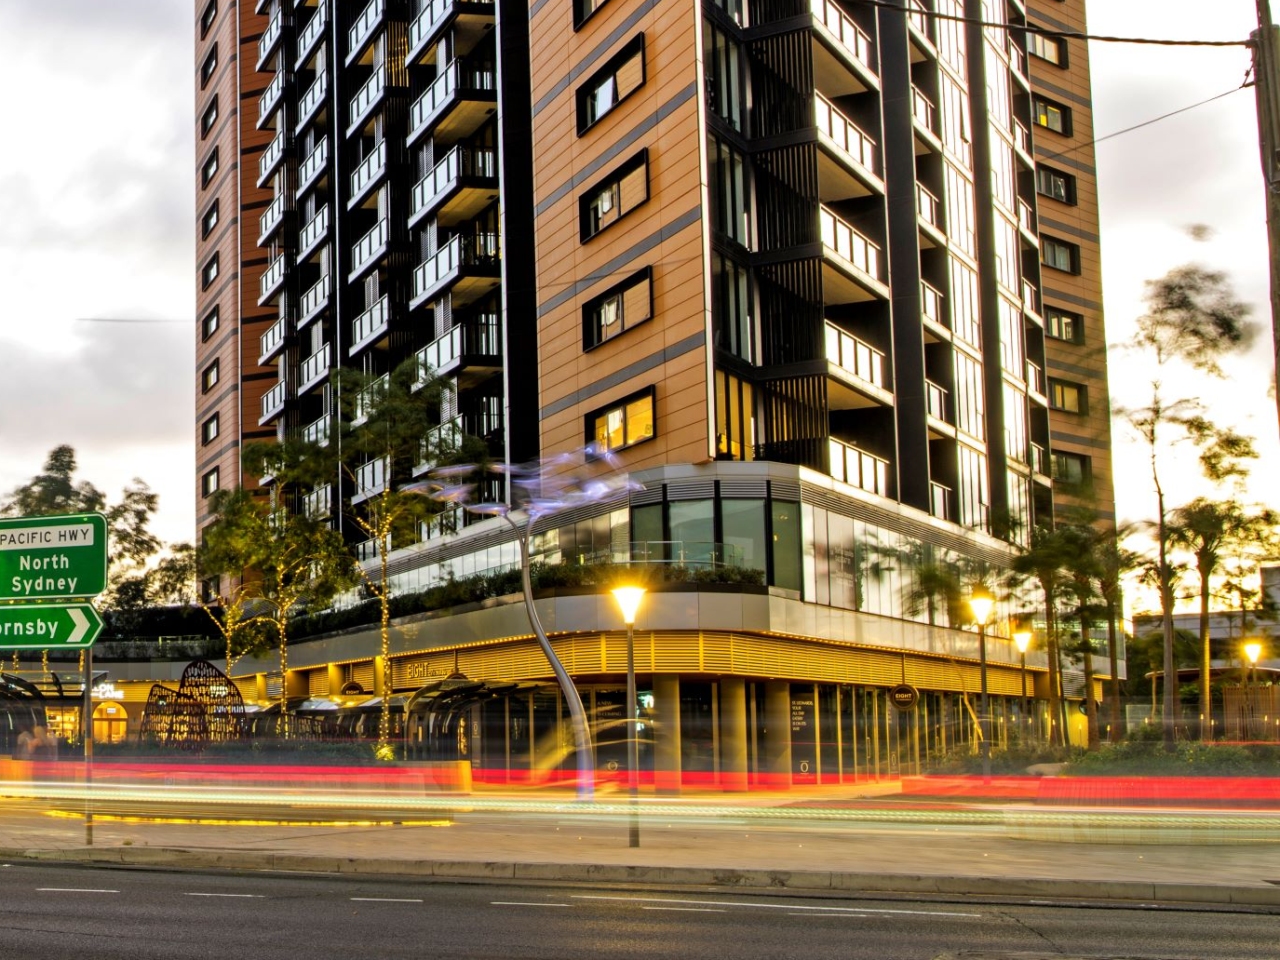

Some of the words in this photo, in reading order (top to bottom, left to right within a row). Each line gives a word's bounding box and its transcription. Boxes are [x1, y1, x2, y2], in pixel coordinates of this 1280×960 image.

[0, 531, 52, 546] PACIFIC
[58, 528, 90, 542] HWY
[19, 554, 69, 571] North
[11, 575, 78, 595] Sydney
[407, 662, 429, 678] EIGHT
